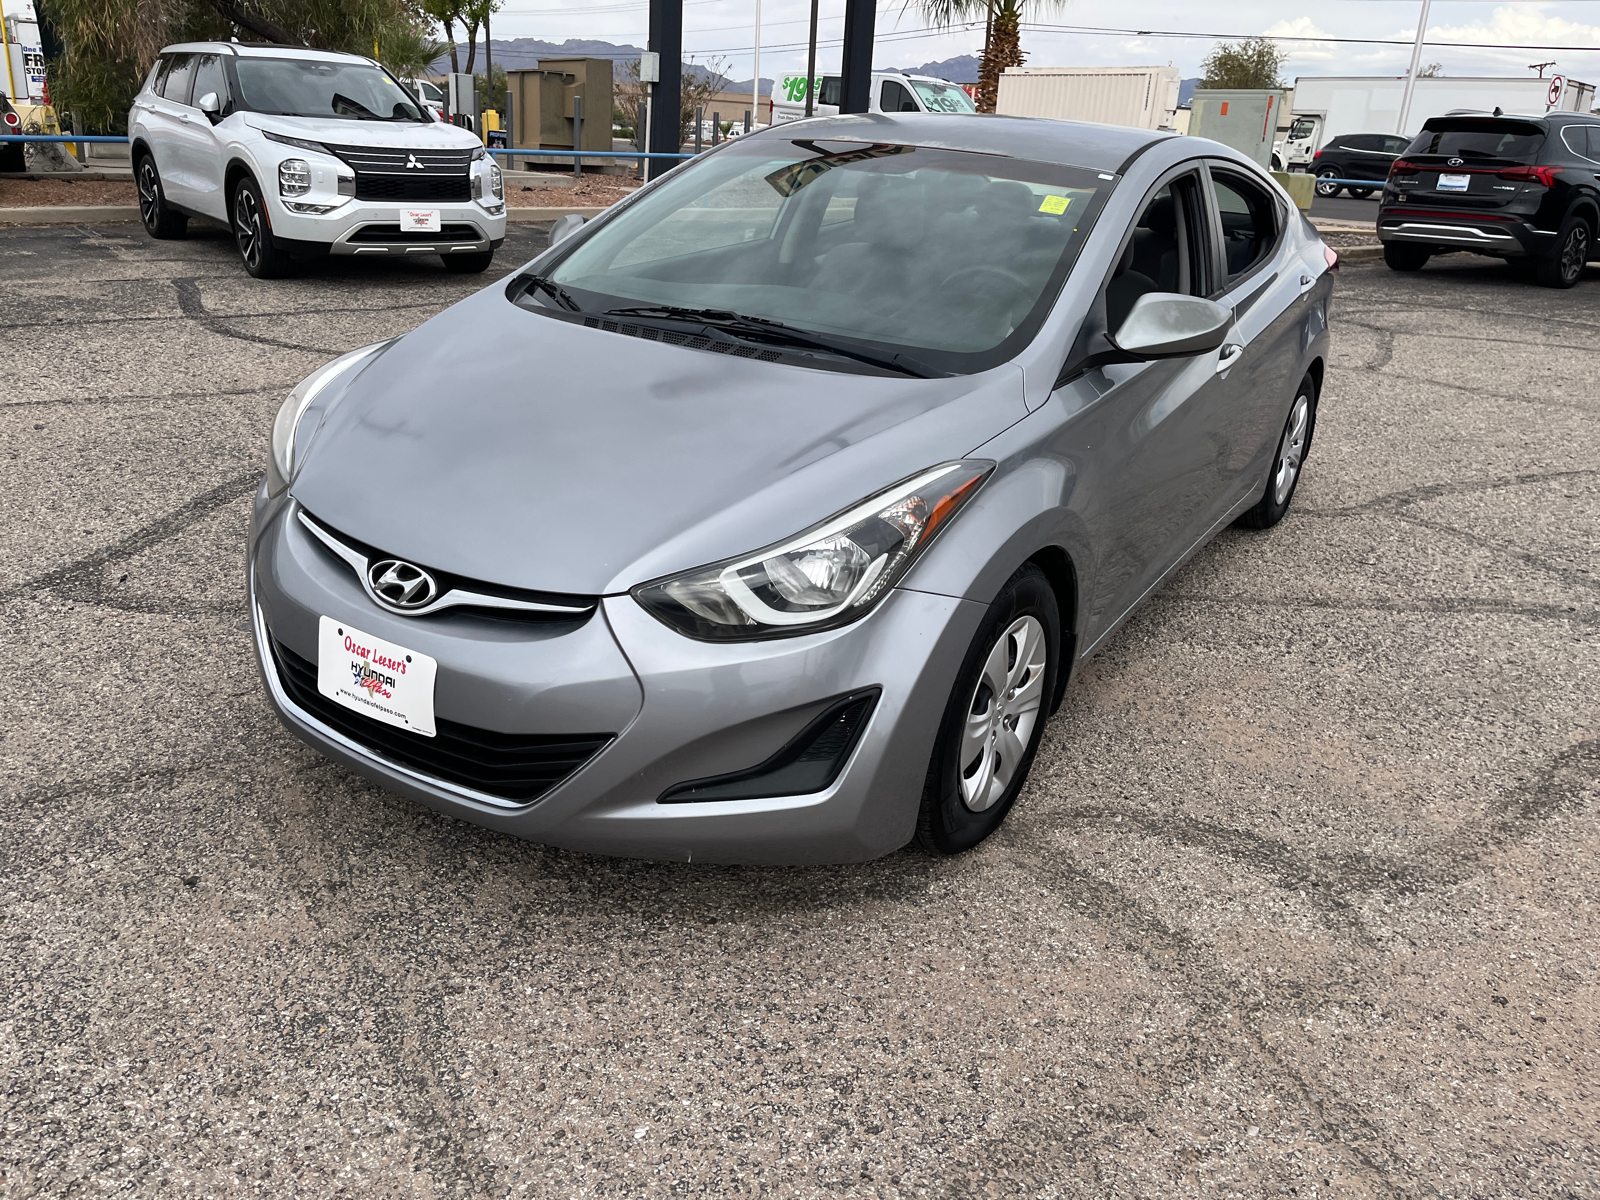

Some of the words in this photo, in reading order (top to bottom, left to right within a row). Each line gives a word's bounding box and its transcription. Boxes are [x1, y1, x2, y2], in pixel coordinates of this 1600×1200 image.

[24, 54, 44, 66] FR
[344, 635, 371, 660] Oscar
[372, 648, 407, 675] Leeser's
[351, 660, 396, 688] HYUNDAI
[340, 688, 407, 719] www.hyundaiofelpaso.com
[371, 680, 392, 699] Paso
